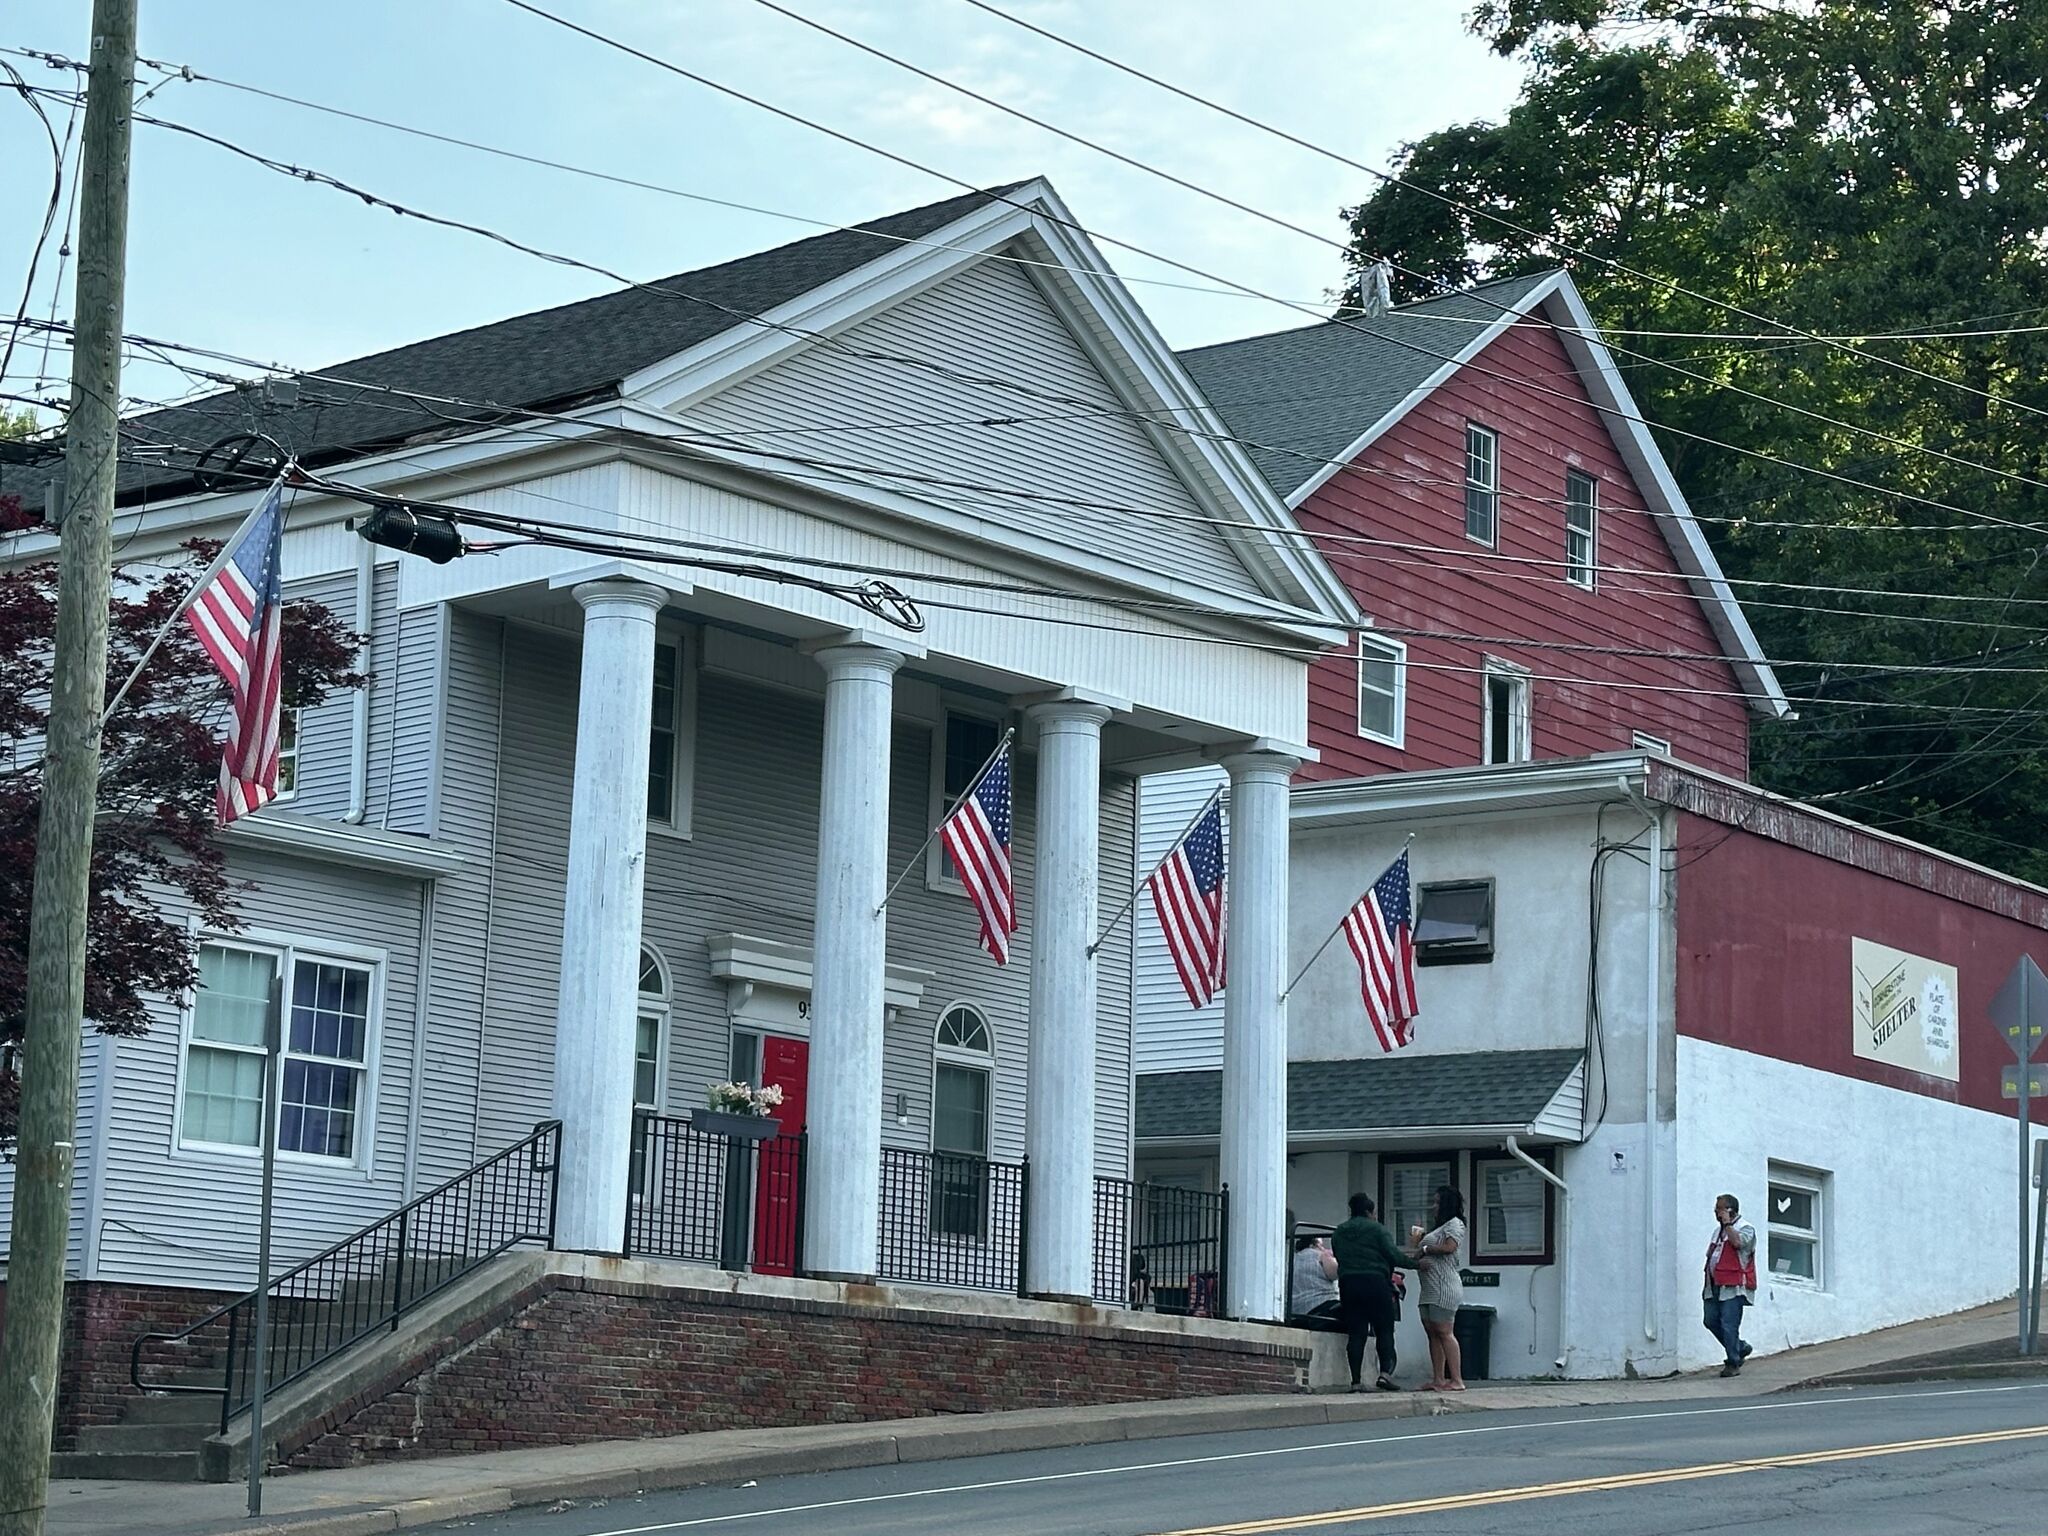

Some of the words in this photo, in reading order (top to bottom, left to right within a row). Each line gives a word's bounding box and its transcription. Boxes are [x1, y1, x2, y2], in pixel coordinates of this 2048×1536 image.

[1929, 992, 1945, 1005] PLACE
[1933, 1004, 1941, 1014] OF
[1873, 996, 1916, 1050] SHELTER
[1927, 1014, 1947, 1027] CARING
[1932, 1026, 1944, 1038] AND
[1926, 1036, 1949, 1049] SHARING
